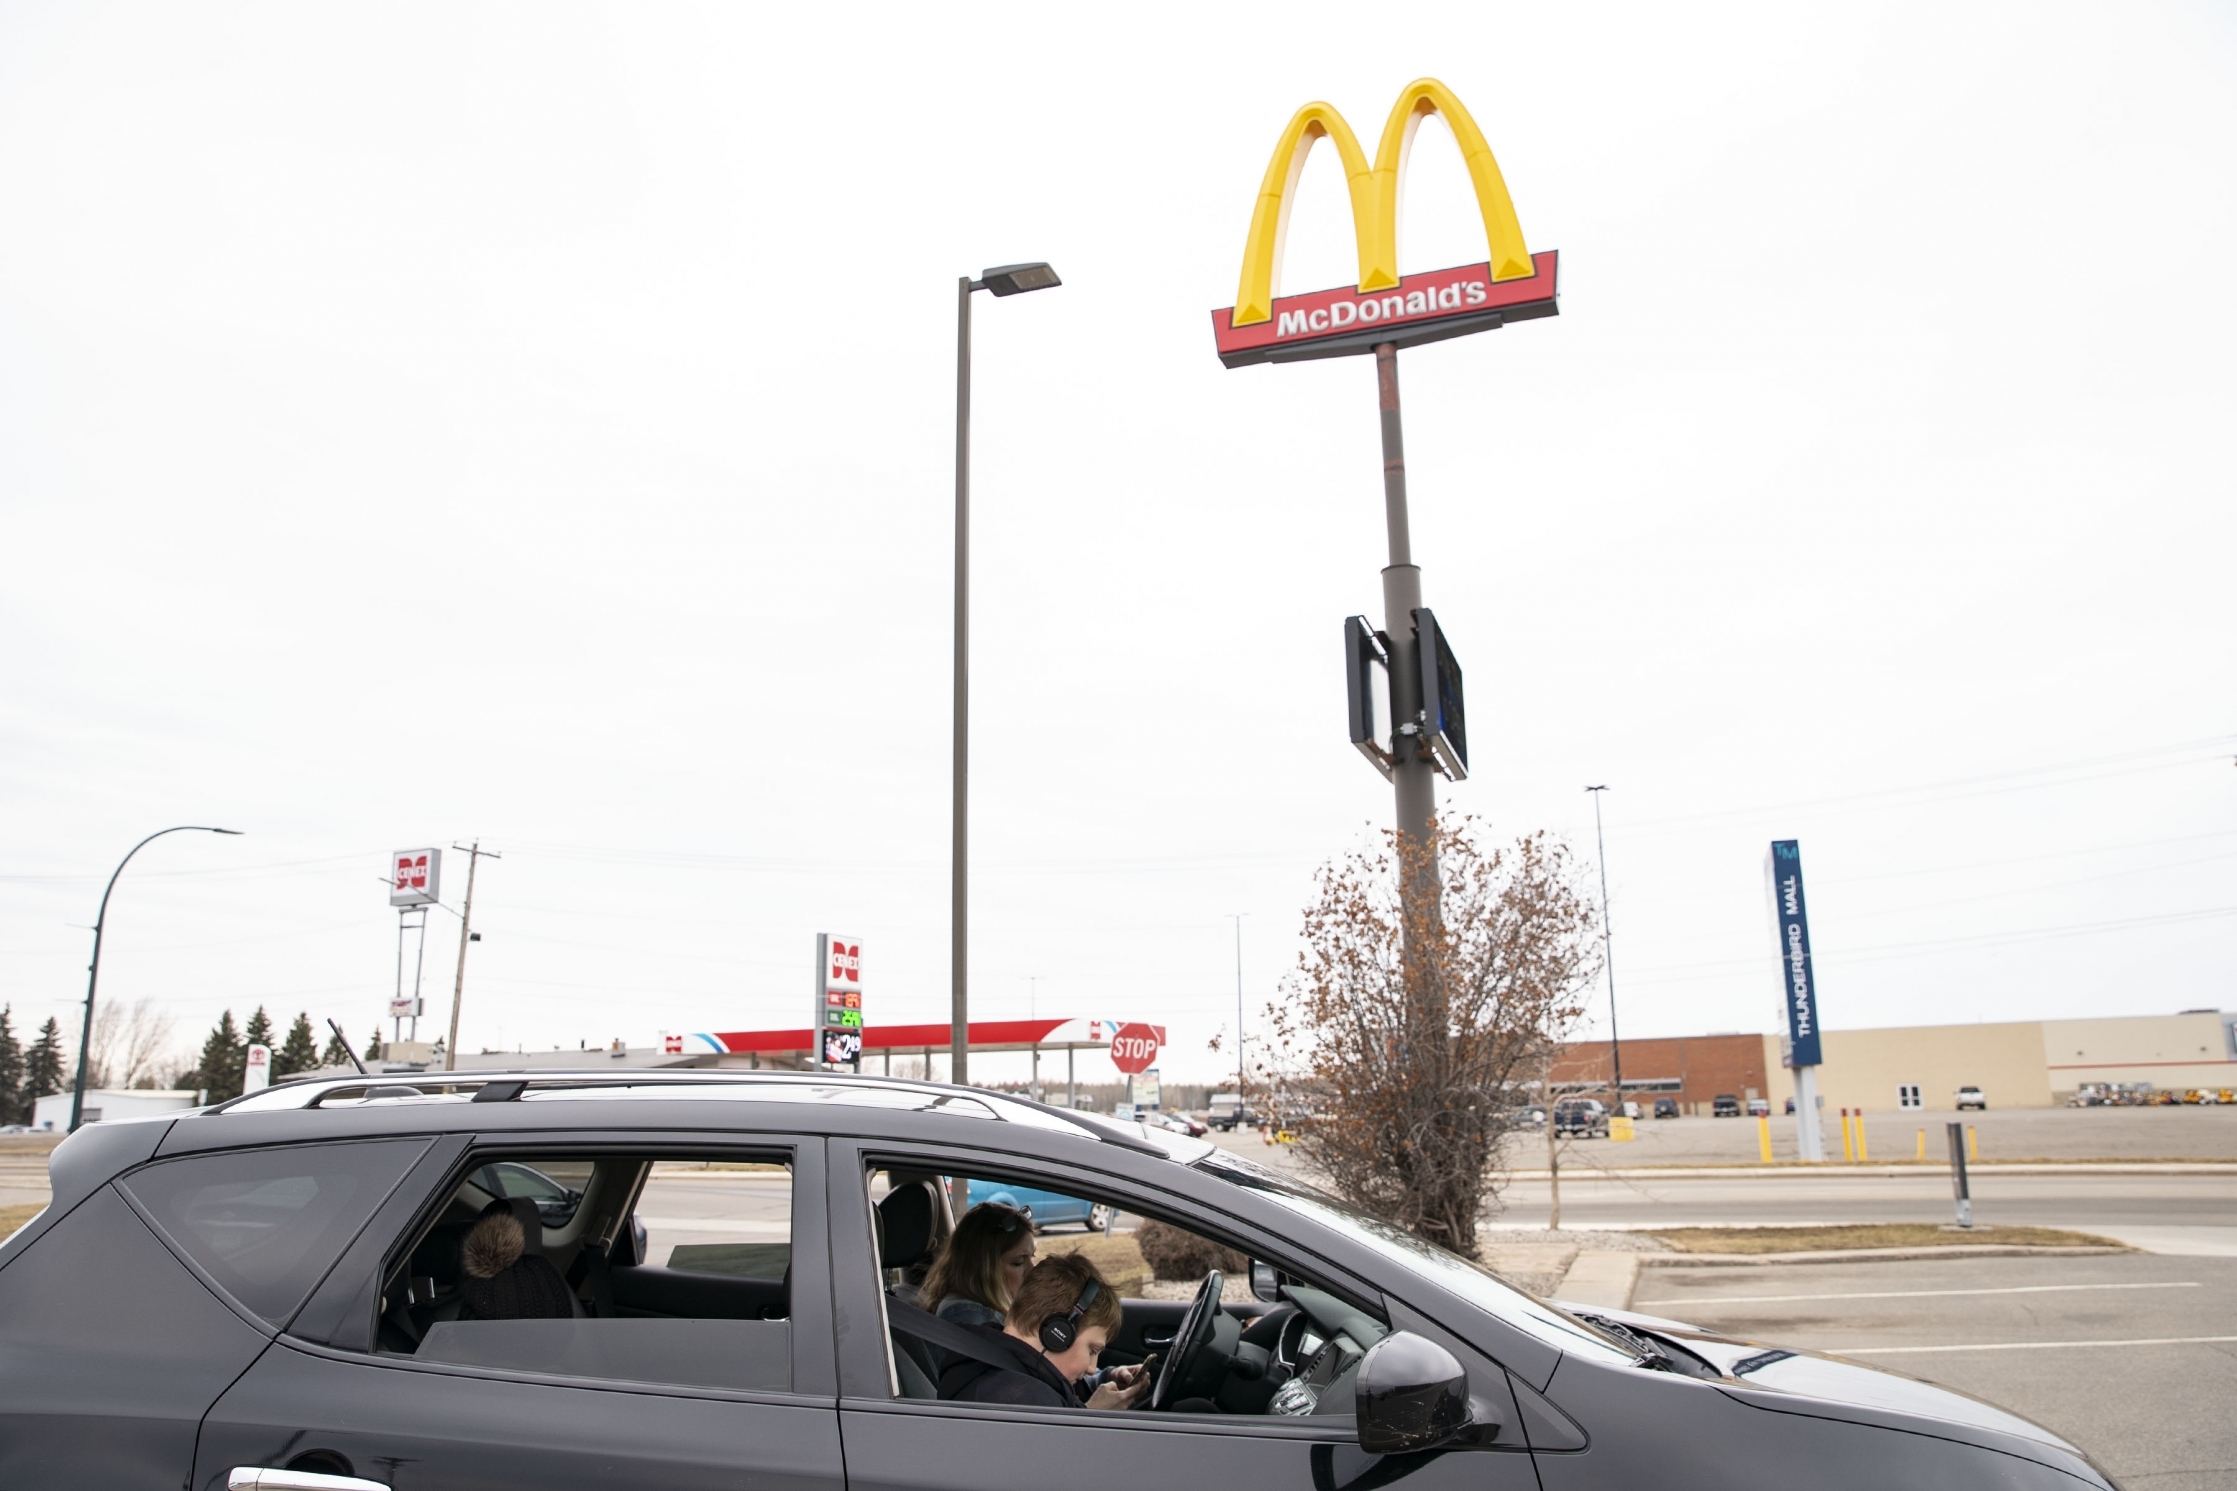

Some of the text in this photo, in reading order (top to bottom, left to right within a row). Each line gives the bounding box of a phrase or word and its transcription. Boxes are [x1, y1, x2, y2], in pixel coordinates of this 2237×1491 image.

[1276, 281, 1487, 337] McDonald's
[1774, 842, 1799, 860] TM
[832, 952, 860, 970] CENEX
[1783, 875, 1811, 1038] THUNDERBIRD MALL
[1112, 1037, 1156, 1059] STOP
